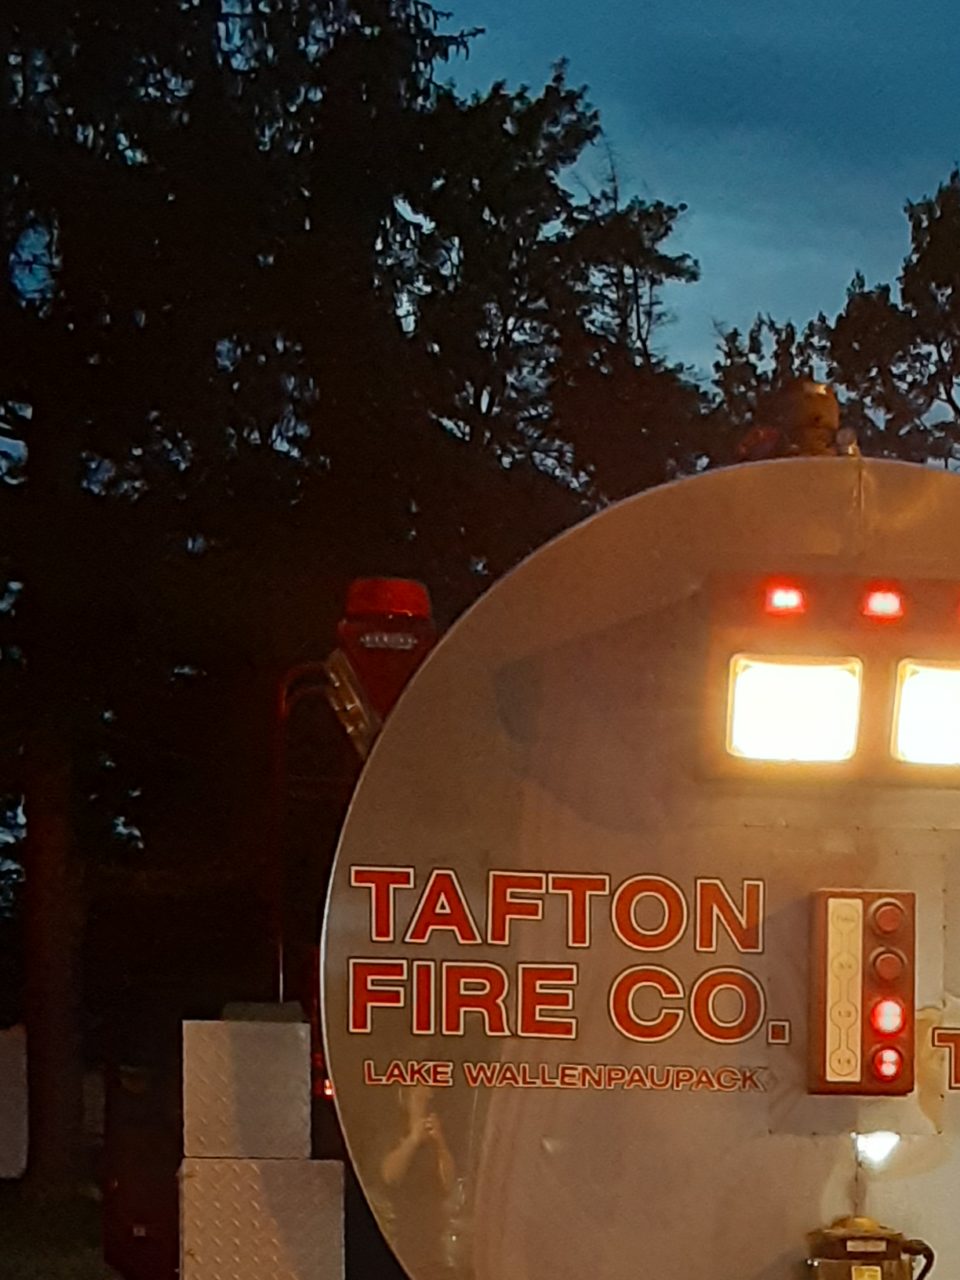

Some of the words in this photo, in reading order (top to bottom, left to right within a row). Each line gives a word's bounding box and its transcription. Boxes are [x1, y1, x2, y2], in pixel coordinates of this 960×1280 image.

[349, 864, 766, 954] TAFTON
[347, 957, 579, 1040] FIRE
[608, 963, 790, 1046] CO.
[363, 1060, 454, 1088] LAKE
[463, 1061, 769, 1092] WALLENPAUPACK
